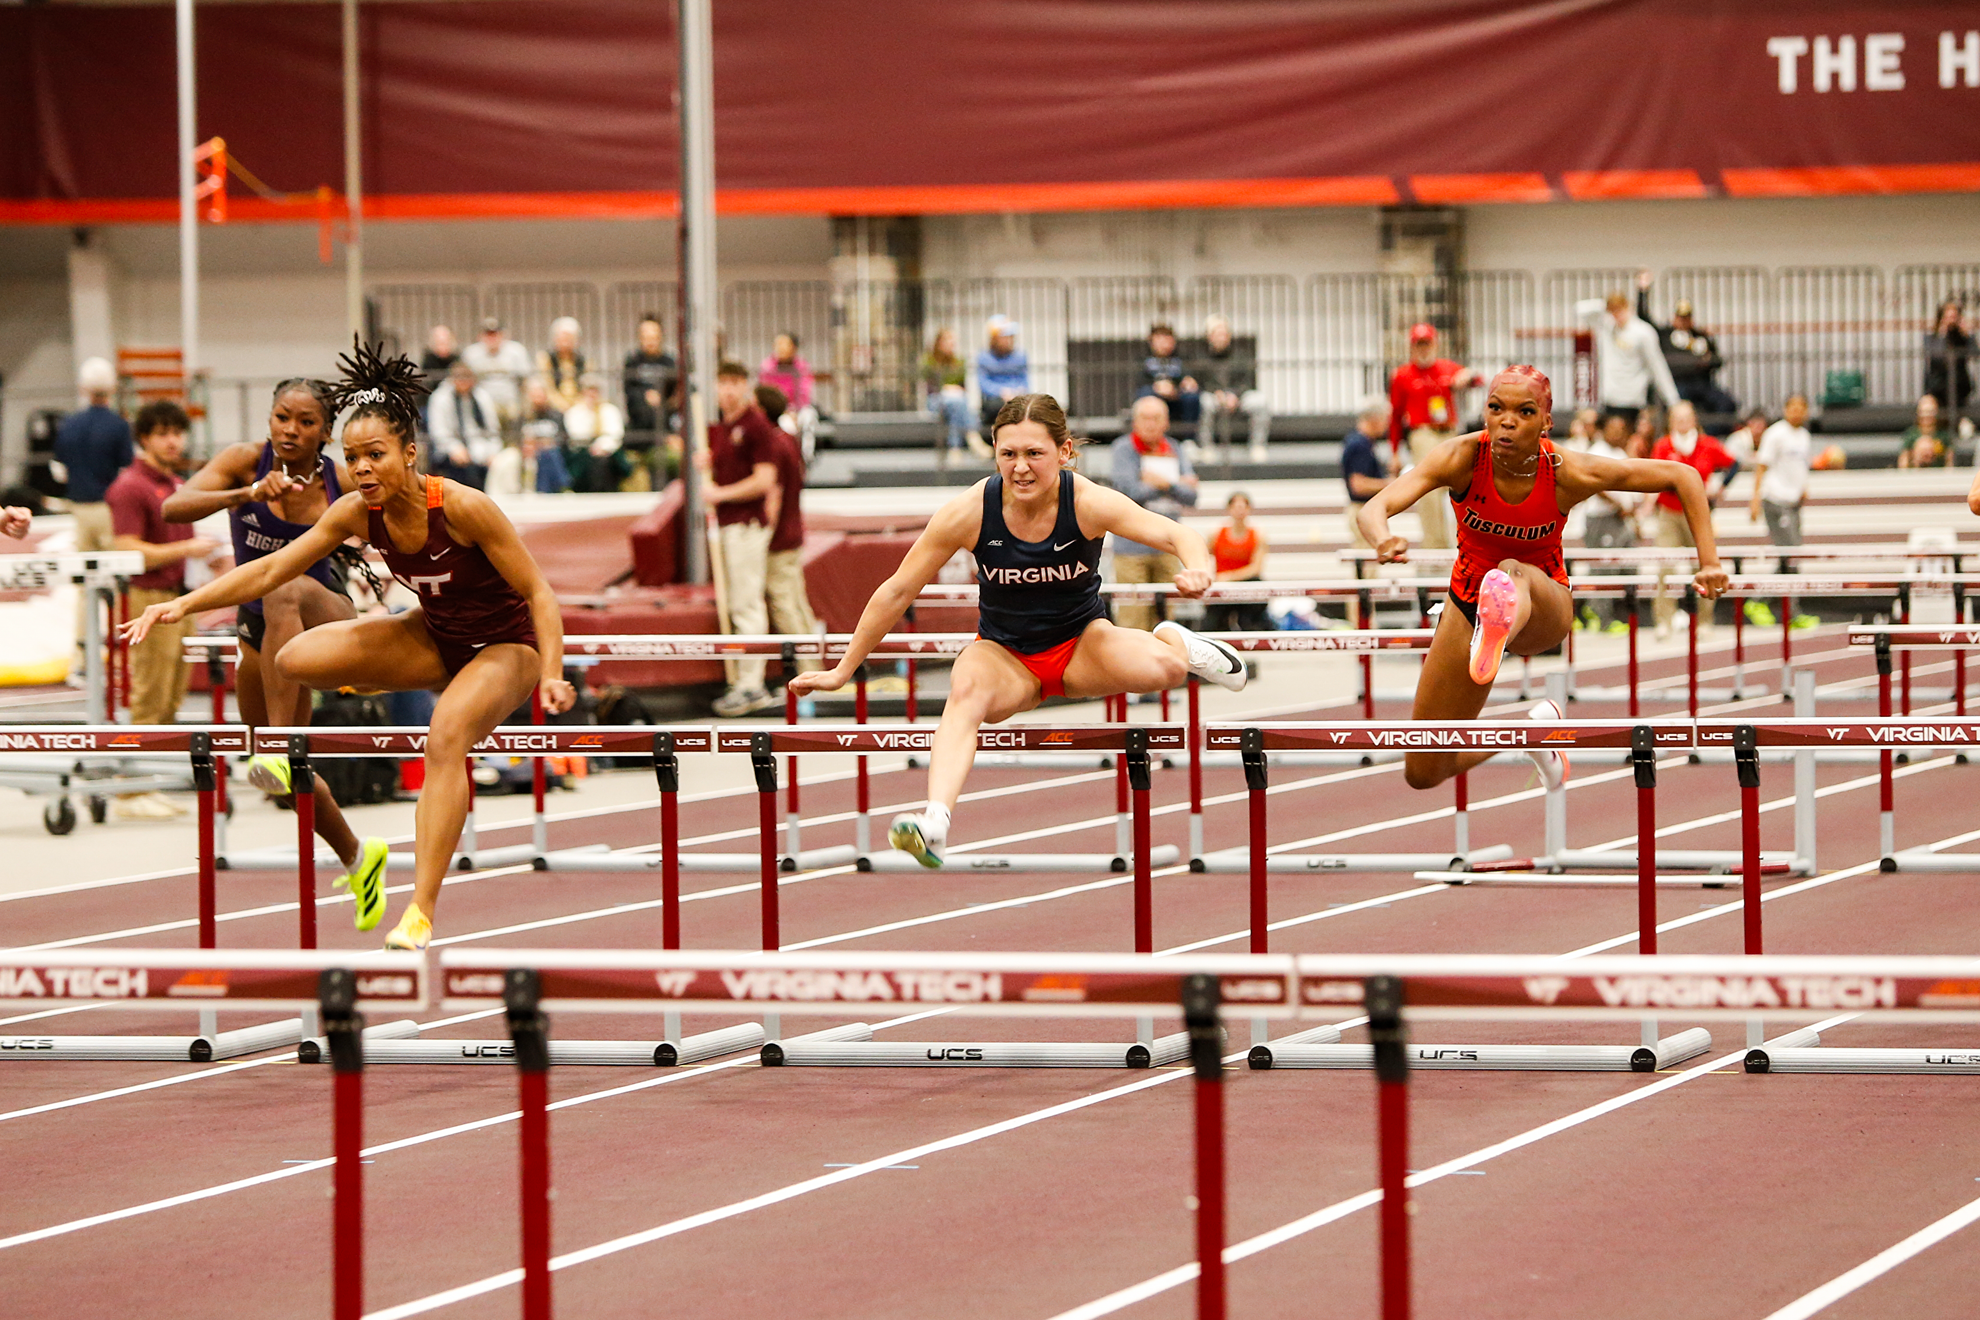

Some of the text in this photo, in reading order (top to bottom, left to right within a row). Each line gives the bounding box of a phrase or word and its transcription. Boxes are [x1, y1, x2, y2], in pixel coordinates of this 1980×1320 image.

[1766, 33, 1906, 95] THE
[1462, 506, 1556, 541] TUSCULUM
[246, 530, 285, 551] HIGH
[982, 560, 1089, 584] VIRGINIA
[836, 734, 858, 747] VT
[976, 732, 1026, 747] ECH
[1042, 732, 1075, 742] ACC
[1149, 734, 1180, 743] UCS
[1210, 736, 1241, 744] UCS
[1330, 730, 1578, 746] VT VIRGINIA TECH ACC
[1656, 732, 1688, 741] UCS
[1701, 732, 1734, 740] UCS
[1826, 727, 1850, 741] VT
[1865, 726, 1970, 742] VIRGINIA
[40, 734, 96, 749] TECH
[212, 737, 243, 746] UCS
[259, 740, 289, 748] UCS
[371, 736, 394, 749] VT
[500, 735, 558, 749] TECH
[572, 735, 605, 745] ACC
[676, 738, 707, 746] UCS
[44, 968, 148, 997] TECH
[720, 970, 894, 1000] VIRGINIA
[893, 971, 1003, 1000] TECH
[1, 1039, 54, 1049] UCS
[461, 1045, 516, 1057] UCS
[927, 1048, 983, 1060] UCS
